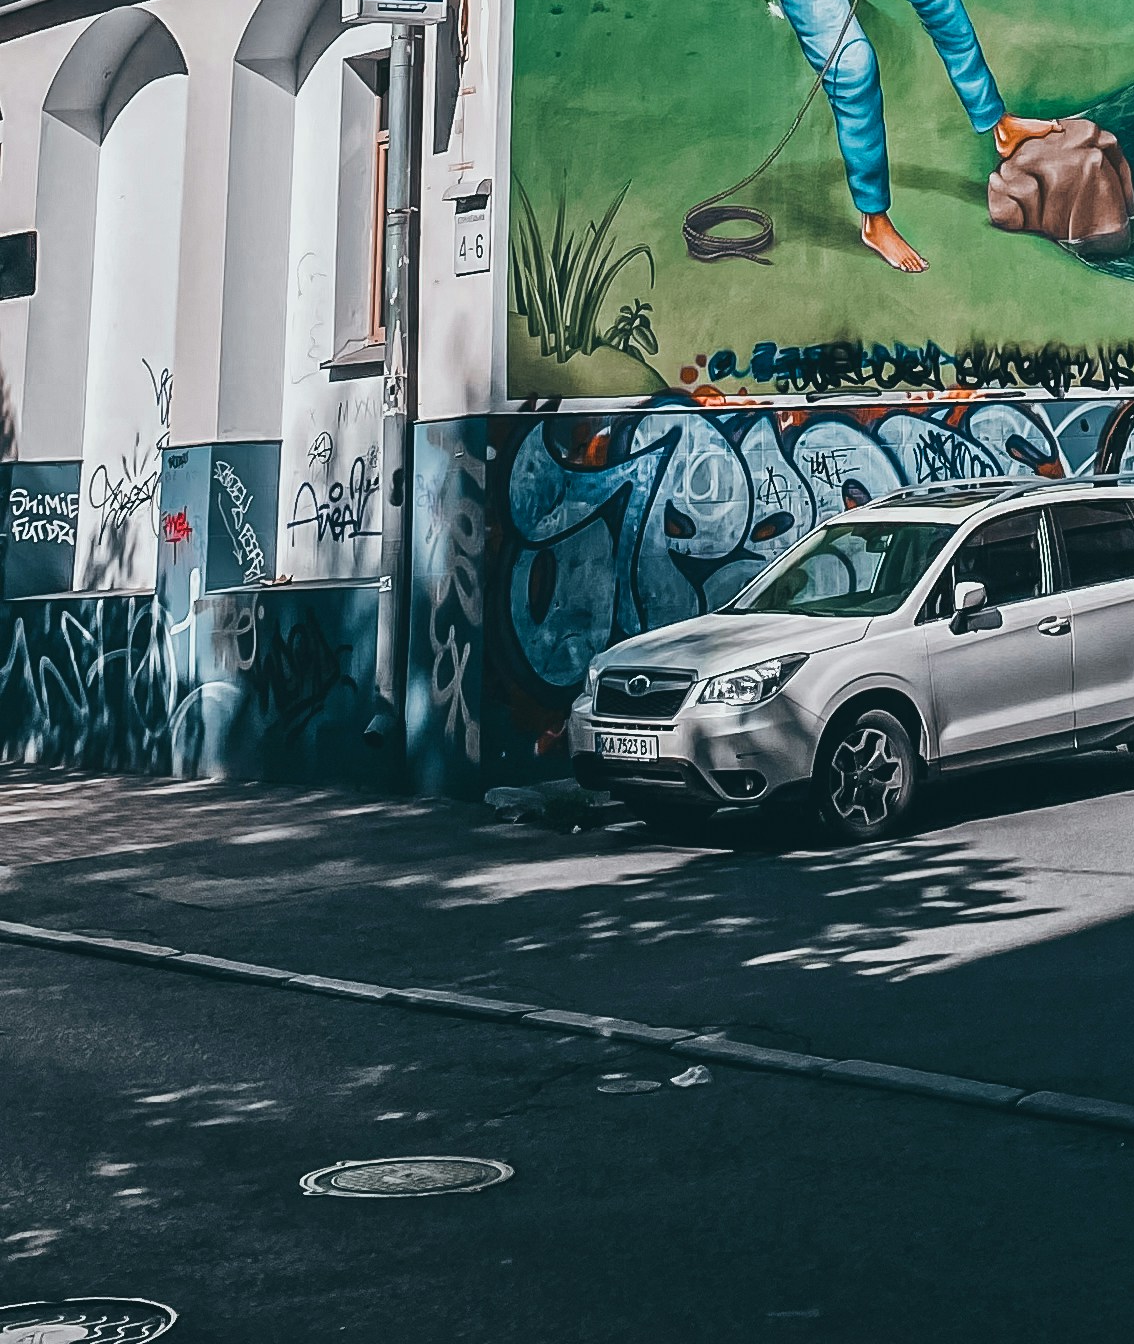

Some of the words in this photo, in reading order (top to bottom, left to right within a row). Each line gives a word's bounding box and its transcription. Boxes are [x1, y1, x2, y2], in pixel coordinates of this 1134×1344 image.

[459, 233, 484, 262] 4-6
[601, 736, 616, 754] KA
[616, 737, 639, 755] 7523
[640, 739, 653, 756] BI
